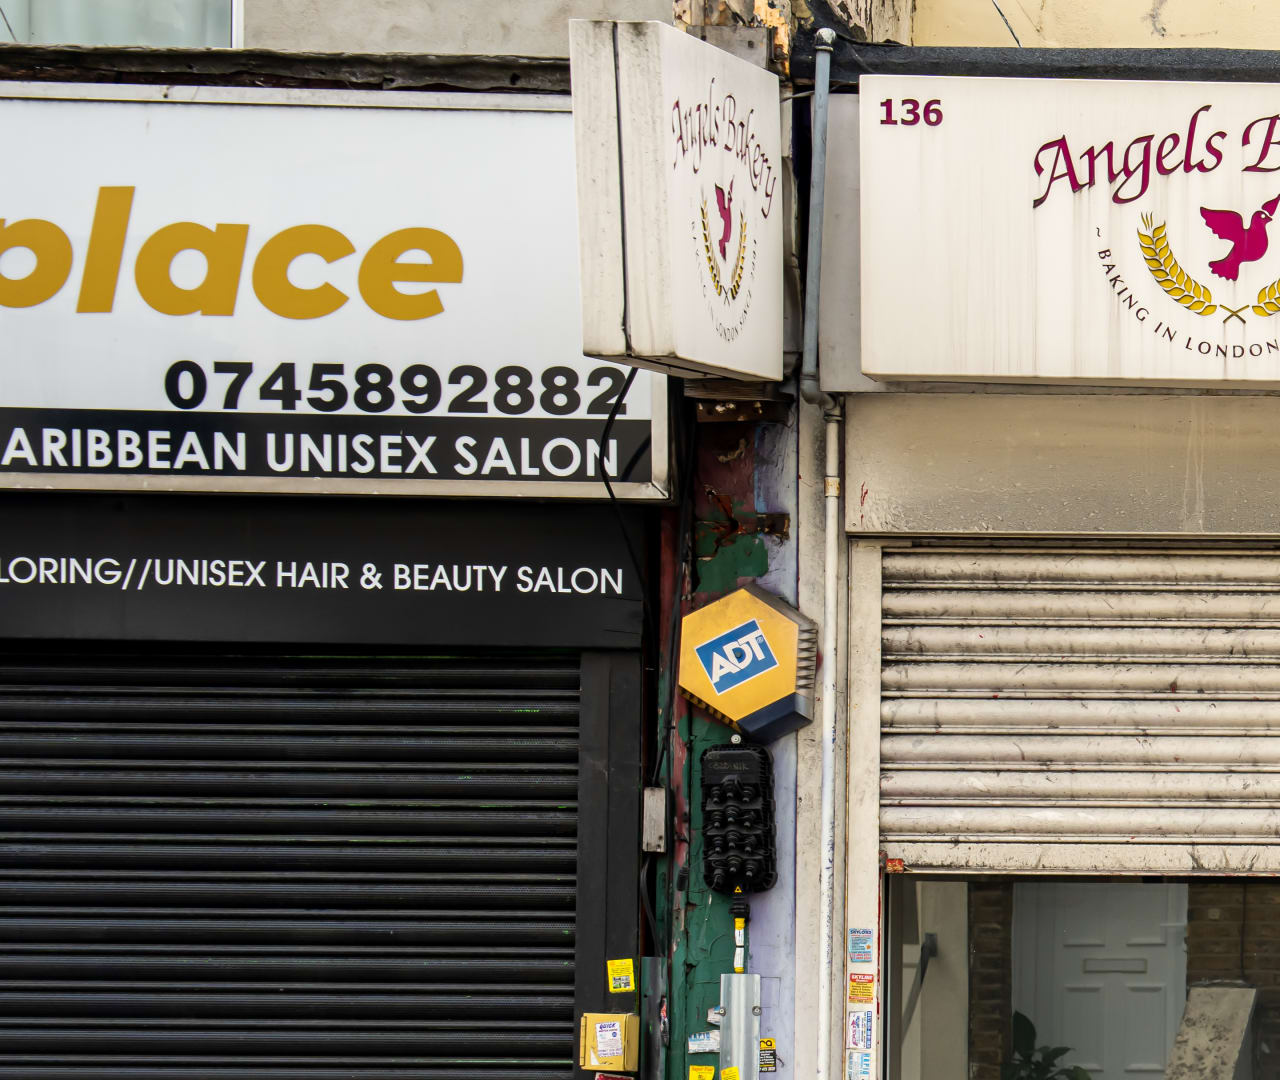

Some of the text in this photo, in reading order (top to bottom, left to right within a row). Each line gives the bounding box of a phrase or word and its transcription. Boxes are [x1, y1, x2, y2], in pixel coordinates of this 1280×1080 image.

[879, 99, 943, 126] 136
[672, 77, 776, 219] Angels Bakery
[1032, 105, 1228, 208] Angels
[1098, 248, 1149, 322] BAKING
[1154, 321, 1177, 342] IN
[1185, 337, 1279, 358] LONDON
[165, 361, 626, 416] 0745892882
[1, 427, 618, 477] ARIBBEAN UNISEX SALON
[277, 561, 350, 589] HAIR
[360, 563, 383, 590] &
[394, 564, 507, 591] BEAUTY
[516, 566, 623, 594] SALON
[711, 630, 767, 683] ADT
